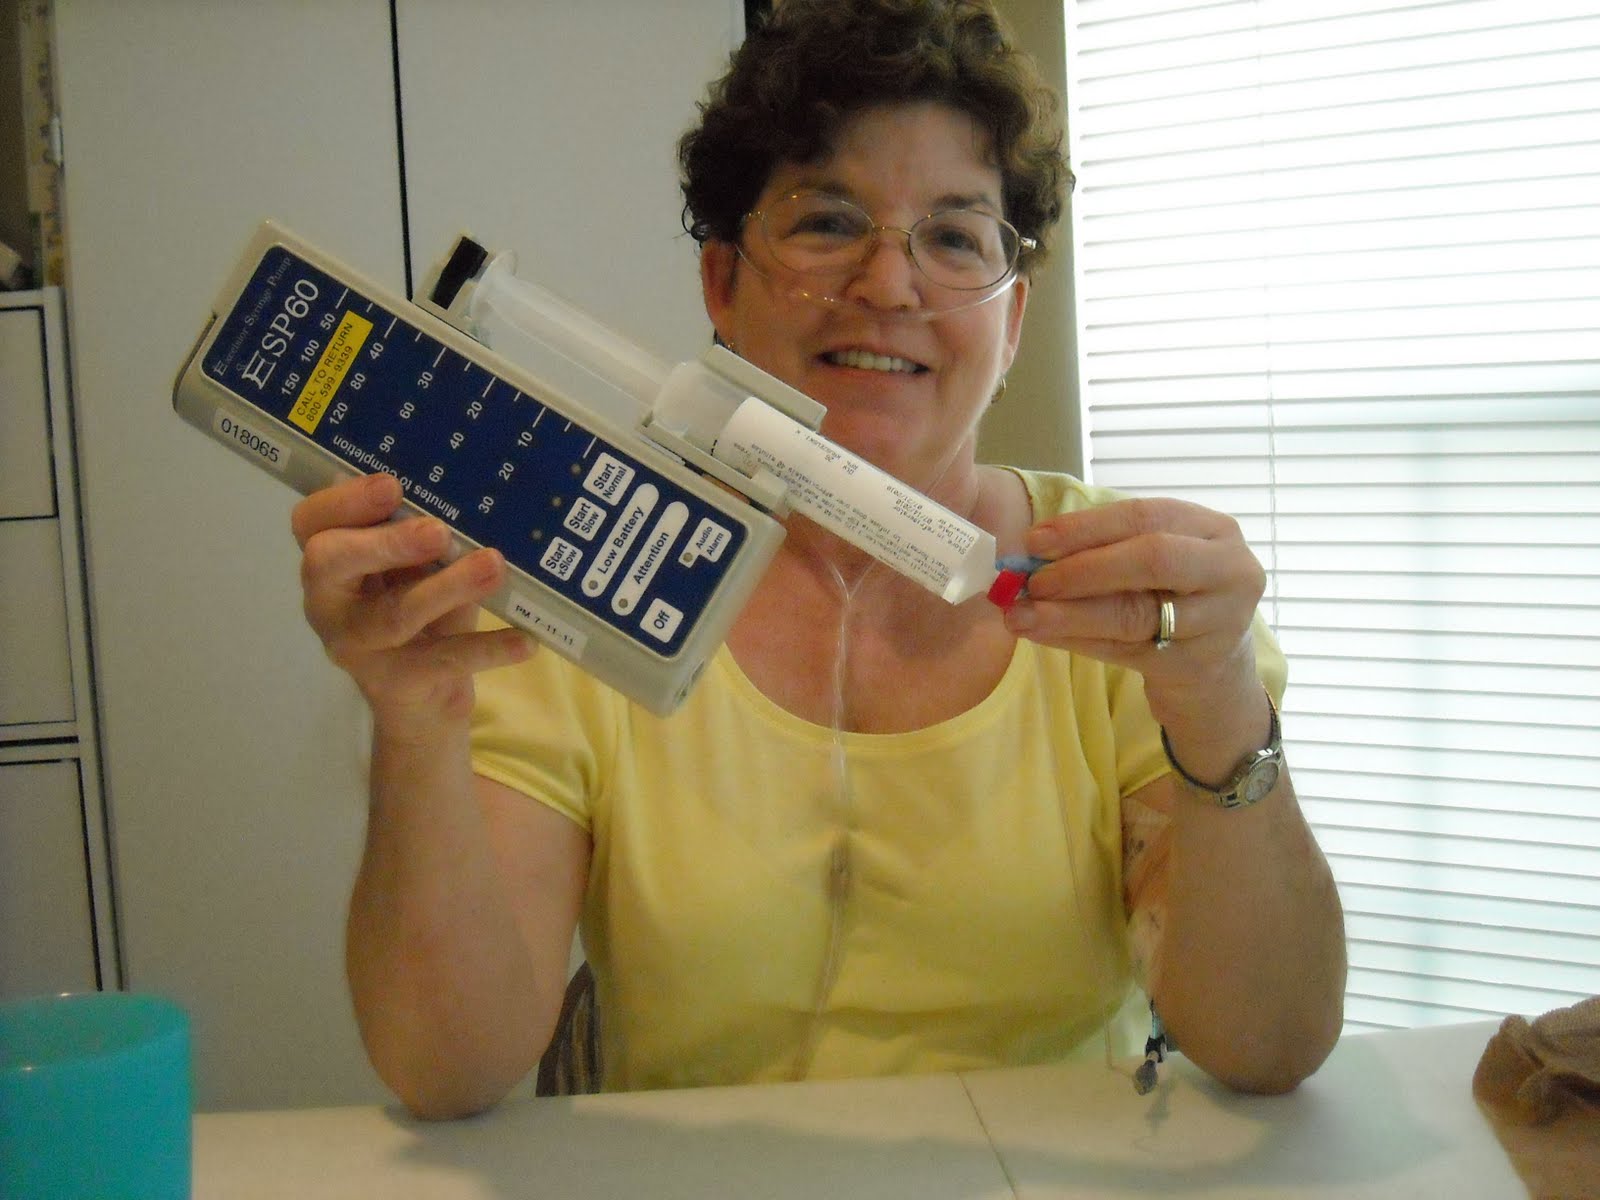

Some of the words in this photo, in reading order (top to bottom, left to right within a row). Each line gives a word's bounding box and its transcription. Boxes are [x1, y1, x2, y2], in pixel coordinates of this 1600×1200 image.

[211, 327, 248, 376] Excelsior
[244, 288, 271, 326] Syringe
[266, 256, 291, 286] Pump
[281, 372, 300, 394] 150
[300, 339, 319, 361] 100
[319, 313, 335, 329] 50
[296, 391, 316, 415] CALL
[313, 368, 326, 383] TO
[323, 322, 352, 367] RETURN
[306, 345, 353, 421] 800-599-9339
[329, 402, 347, 424] 120
[350, 372, 365, 389] 80
[369, 342, 383, 359] 40
[379, 435, 394, 452] 90
[399, 402, 414, 418] 60
[417, 371, 432, 388] 30
[221, 418, 280, 463] 018065
[428, 465, 443, 482] 60
[449, 432, 463, 449] 40
[466, 401, 482, 419] 20
[396, 476, 412, 490] to
[478, 495, 493, 513] 30
[498, 462, 514, 480] 20
[517, 431, 532, 446] 10
[593, 463, 615, 489] Start
[602, 465, 626, 498] Normal
[413, 484, 459, 520] Minutes
[568, 502, 590, 529] Start
[580, 511, 599, 533] Slow
[695, 526, 712, 549] Audio
[545, 542, 567, 569] Start
[597, 548, 617, 574] Low
[612, 506, 643, 548] Battery
[706, 532, 723, 556] Alarm
[946, 539, 966, 555] Store
[557, 549, 576, 576] xSlow
[633, 532, 669, 584] Attention
[515, 604, 531, 618] PM
[653, 609, 669, 629] Off
